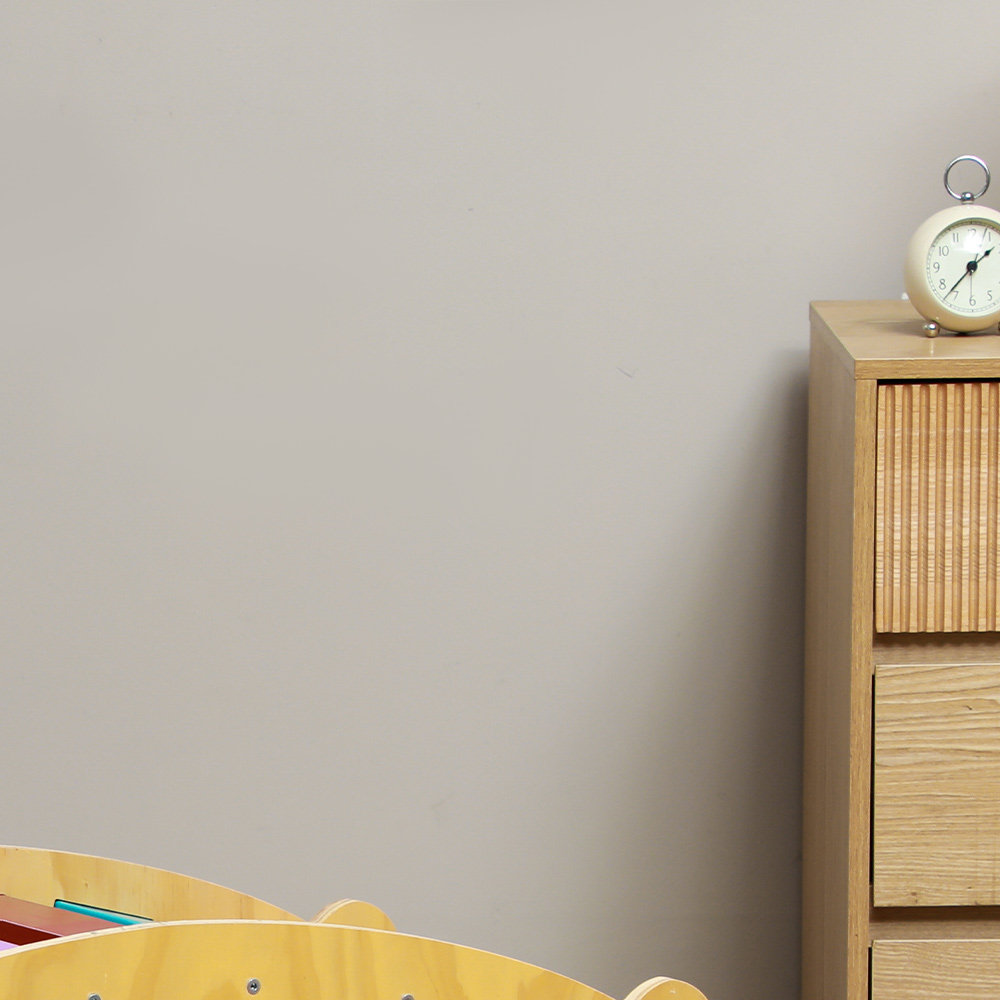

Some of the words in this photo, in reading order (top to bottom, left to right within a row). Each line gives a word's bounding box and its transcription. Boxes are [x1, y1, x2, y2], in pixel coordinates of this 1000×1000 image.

[952, 232, 959, 242] 11
[939, 245, 949, 256] 10
[933, 262, 940, 273] 9
[939, 279, 947, 290] 8
[951, 290, 959, 300] 7
[969, 295, 977, 306] 6
[987, 290, 993, 301] 5
